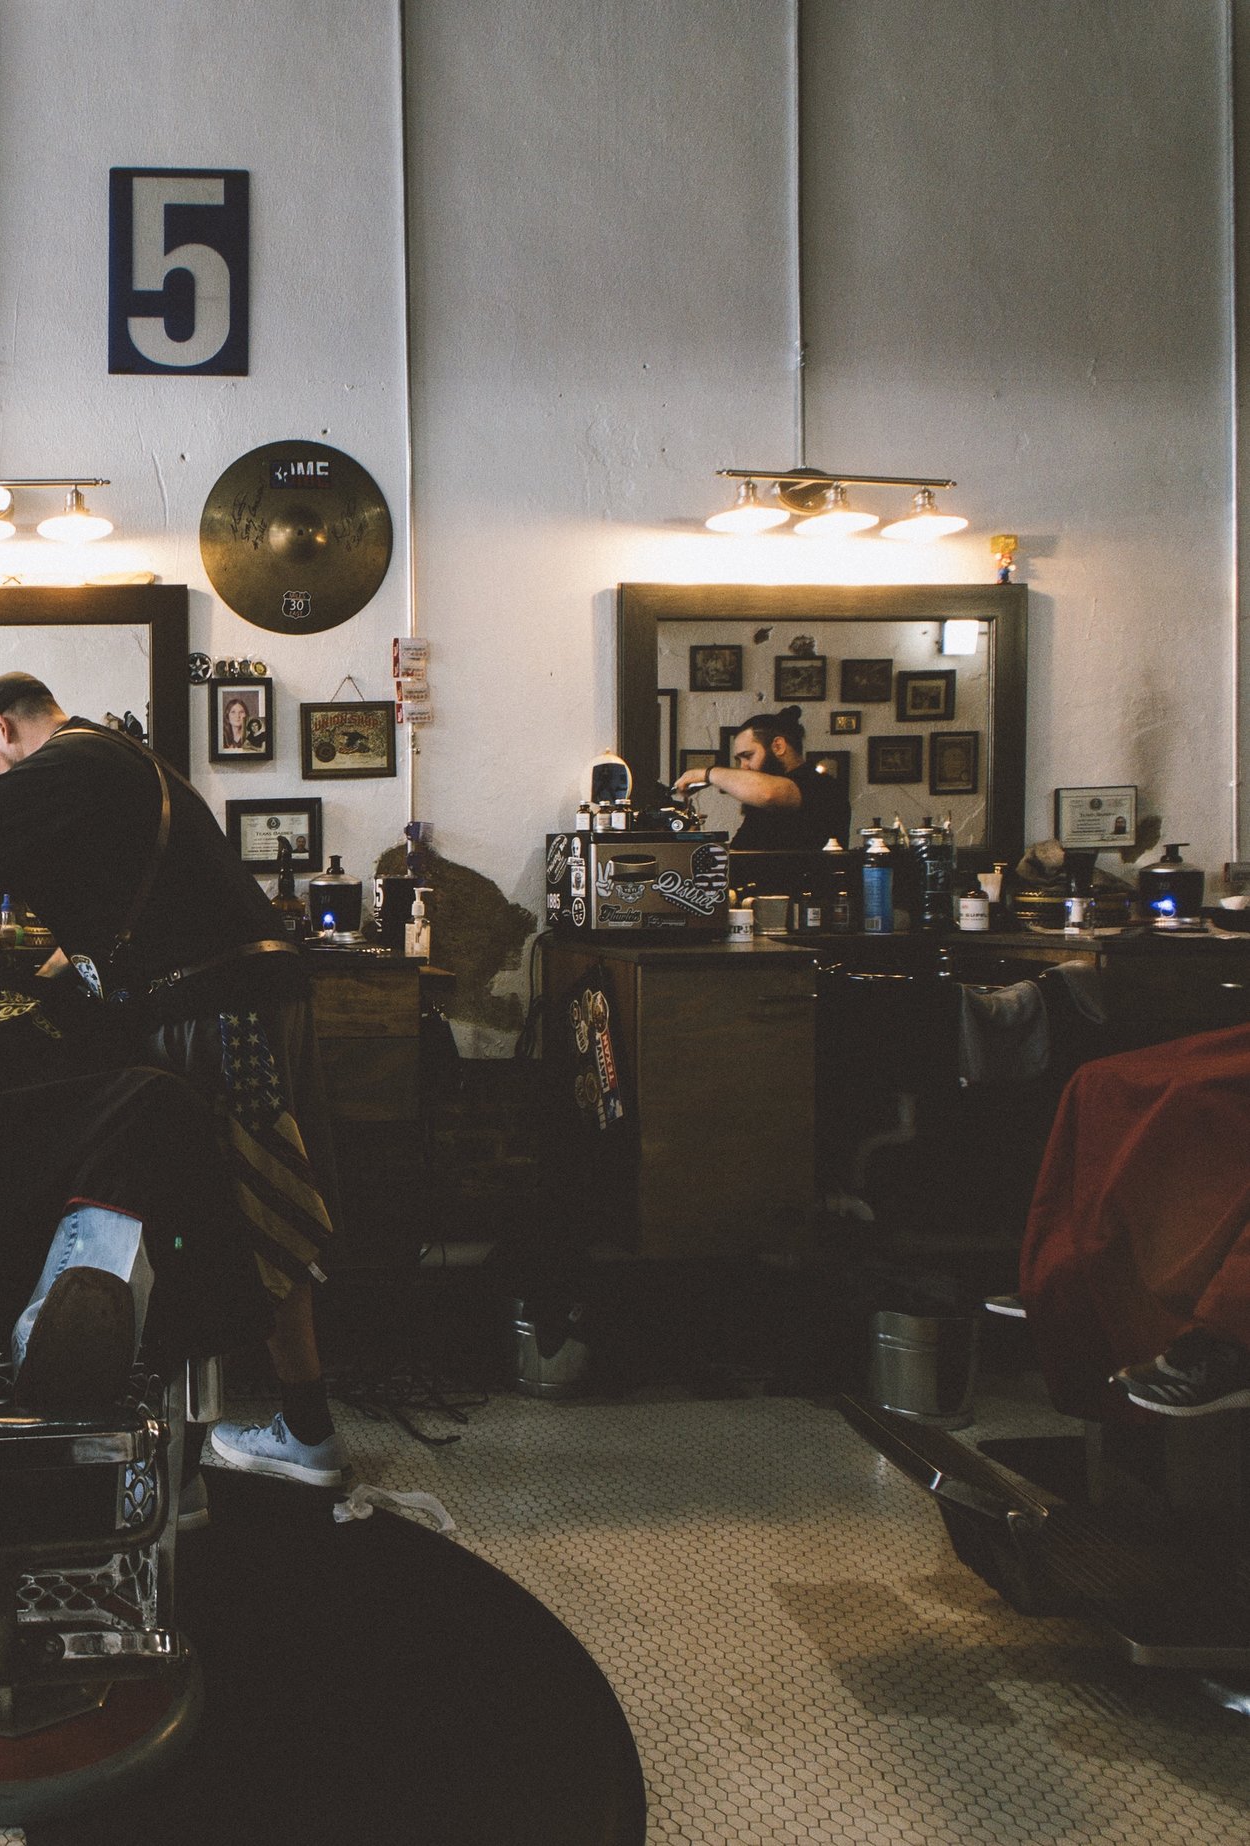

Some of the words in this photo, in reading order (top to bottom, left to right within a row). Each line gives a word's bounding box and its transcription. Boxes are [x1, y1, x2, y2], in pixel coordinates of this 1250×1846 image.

[127, 177, 231, 367] 5
[289, 600, 304, 611] 30
[652, 871, 726, 915] District
